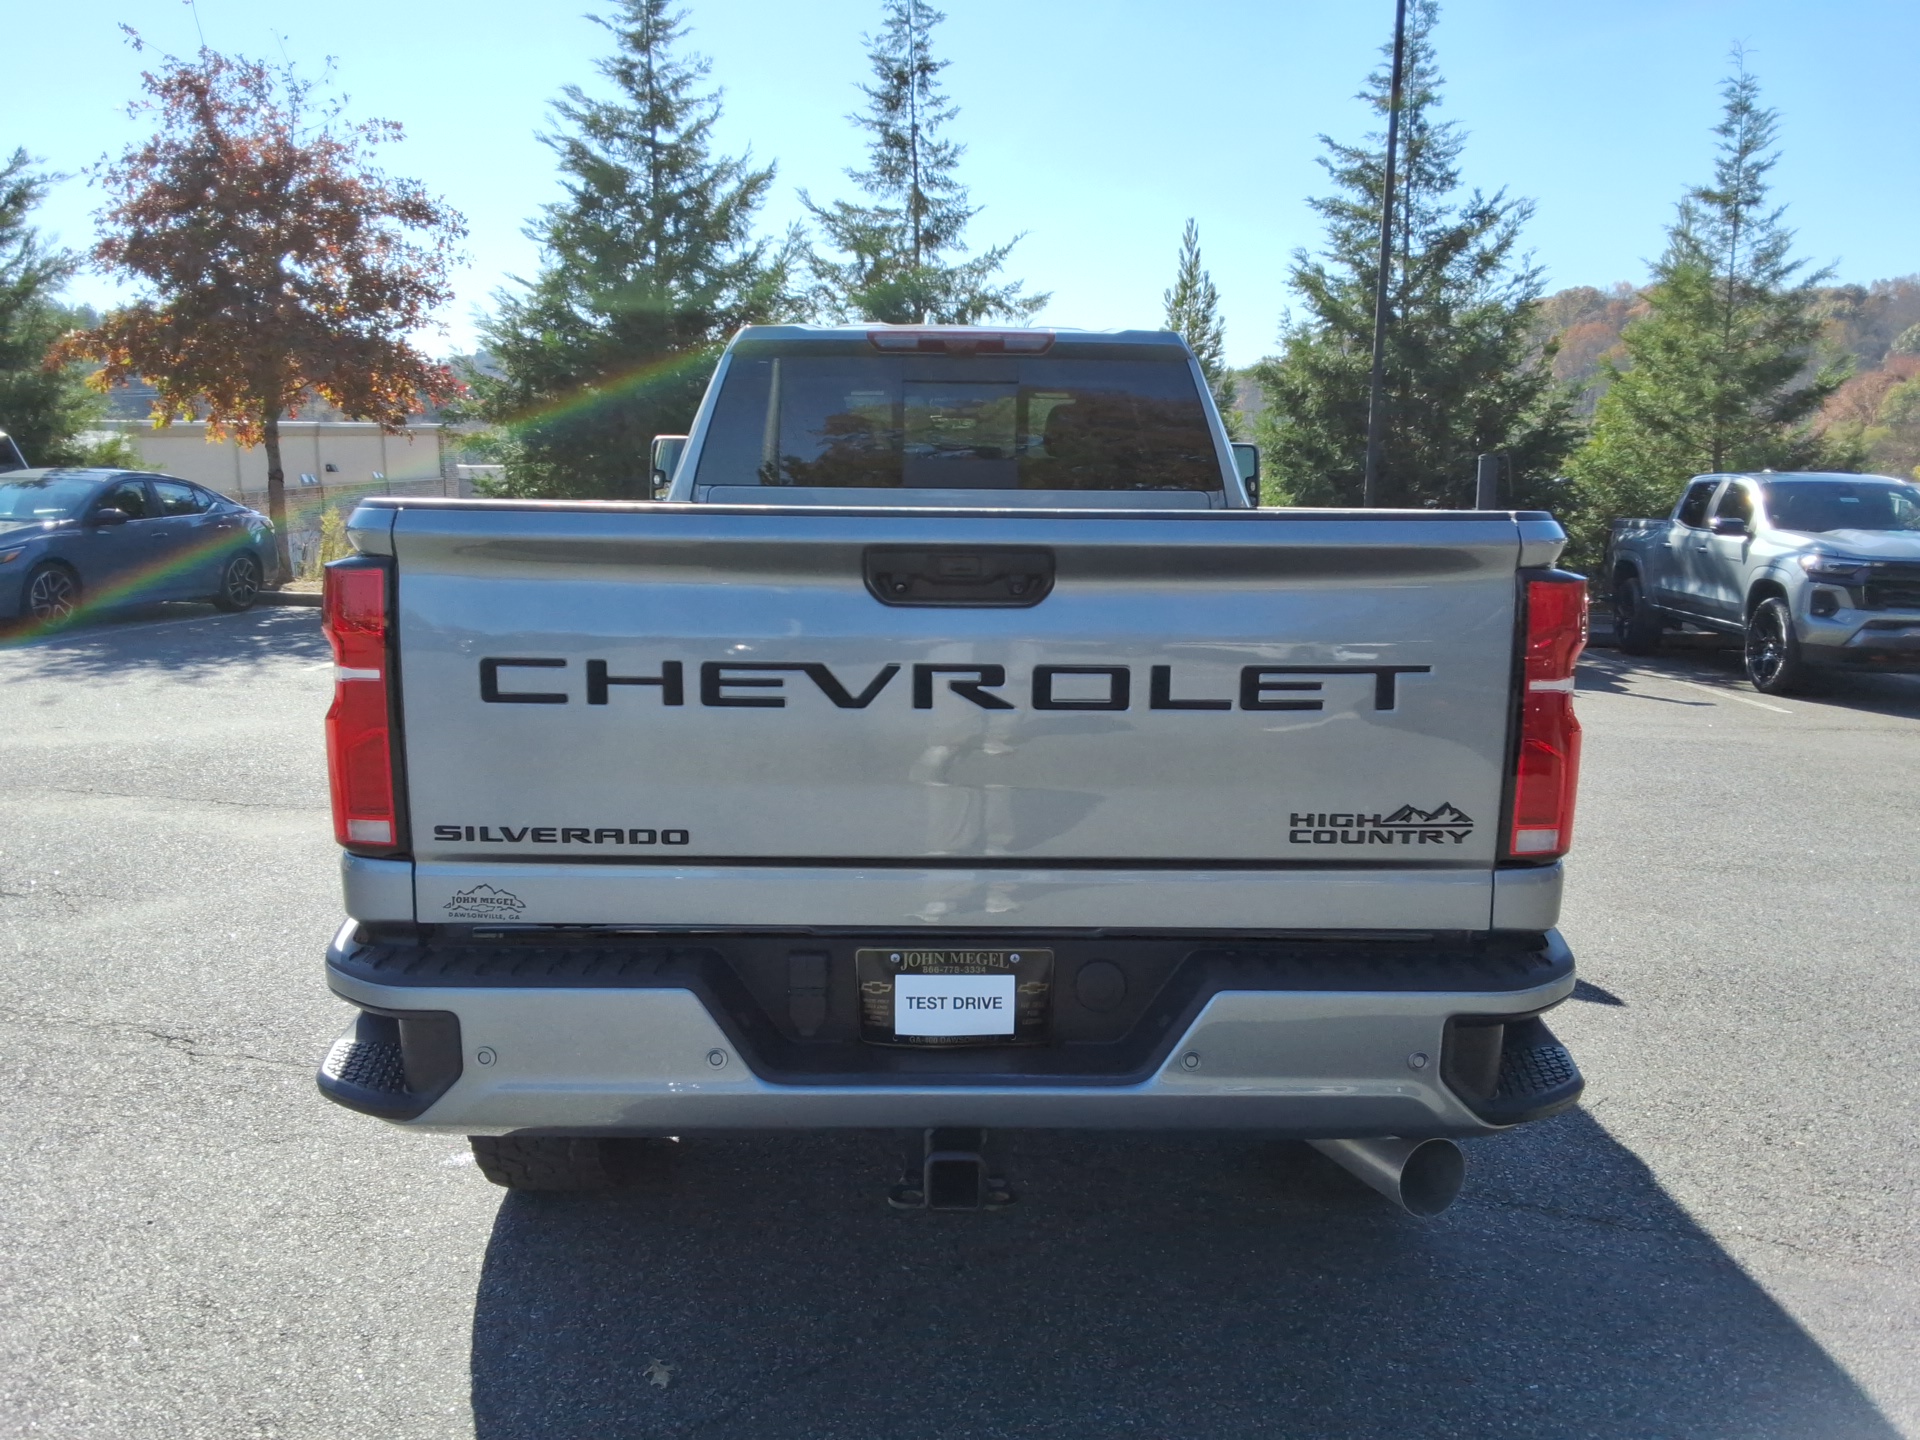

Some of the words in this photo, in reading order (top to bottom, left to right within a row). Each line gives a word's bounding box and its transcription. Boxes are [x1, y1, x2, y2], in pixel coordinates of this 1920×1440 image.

[480, 657, 1431, 710] CHEVROLET
[1290, 812, 1382, 828] HIGH
[434, 825, 690, 845] SILVERADO
[1289, 829, 1473, 844] COUNTRY
[451, 896, 477, 906] JOHN
[480, 897, 516, 907] MEGEL
[448, 912, 506, 920] DAWSONVILLE,
[900, 952, 945, 971] JOHN
[950, 952, 1010, 969] MEGEL
[905, 996, 948, 1010] TEST
[952, 996, 1002, 1010] DRIVE
